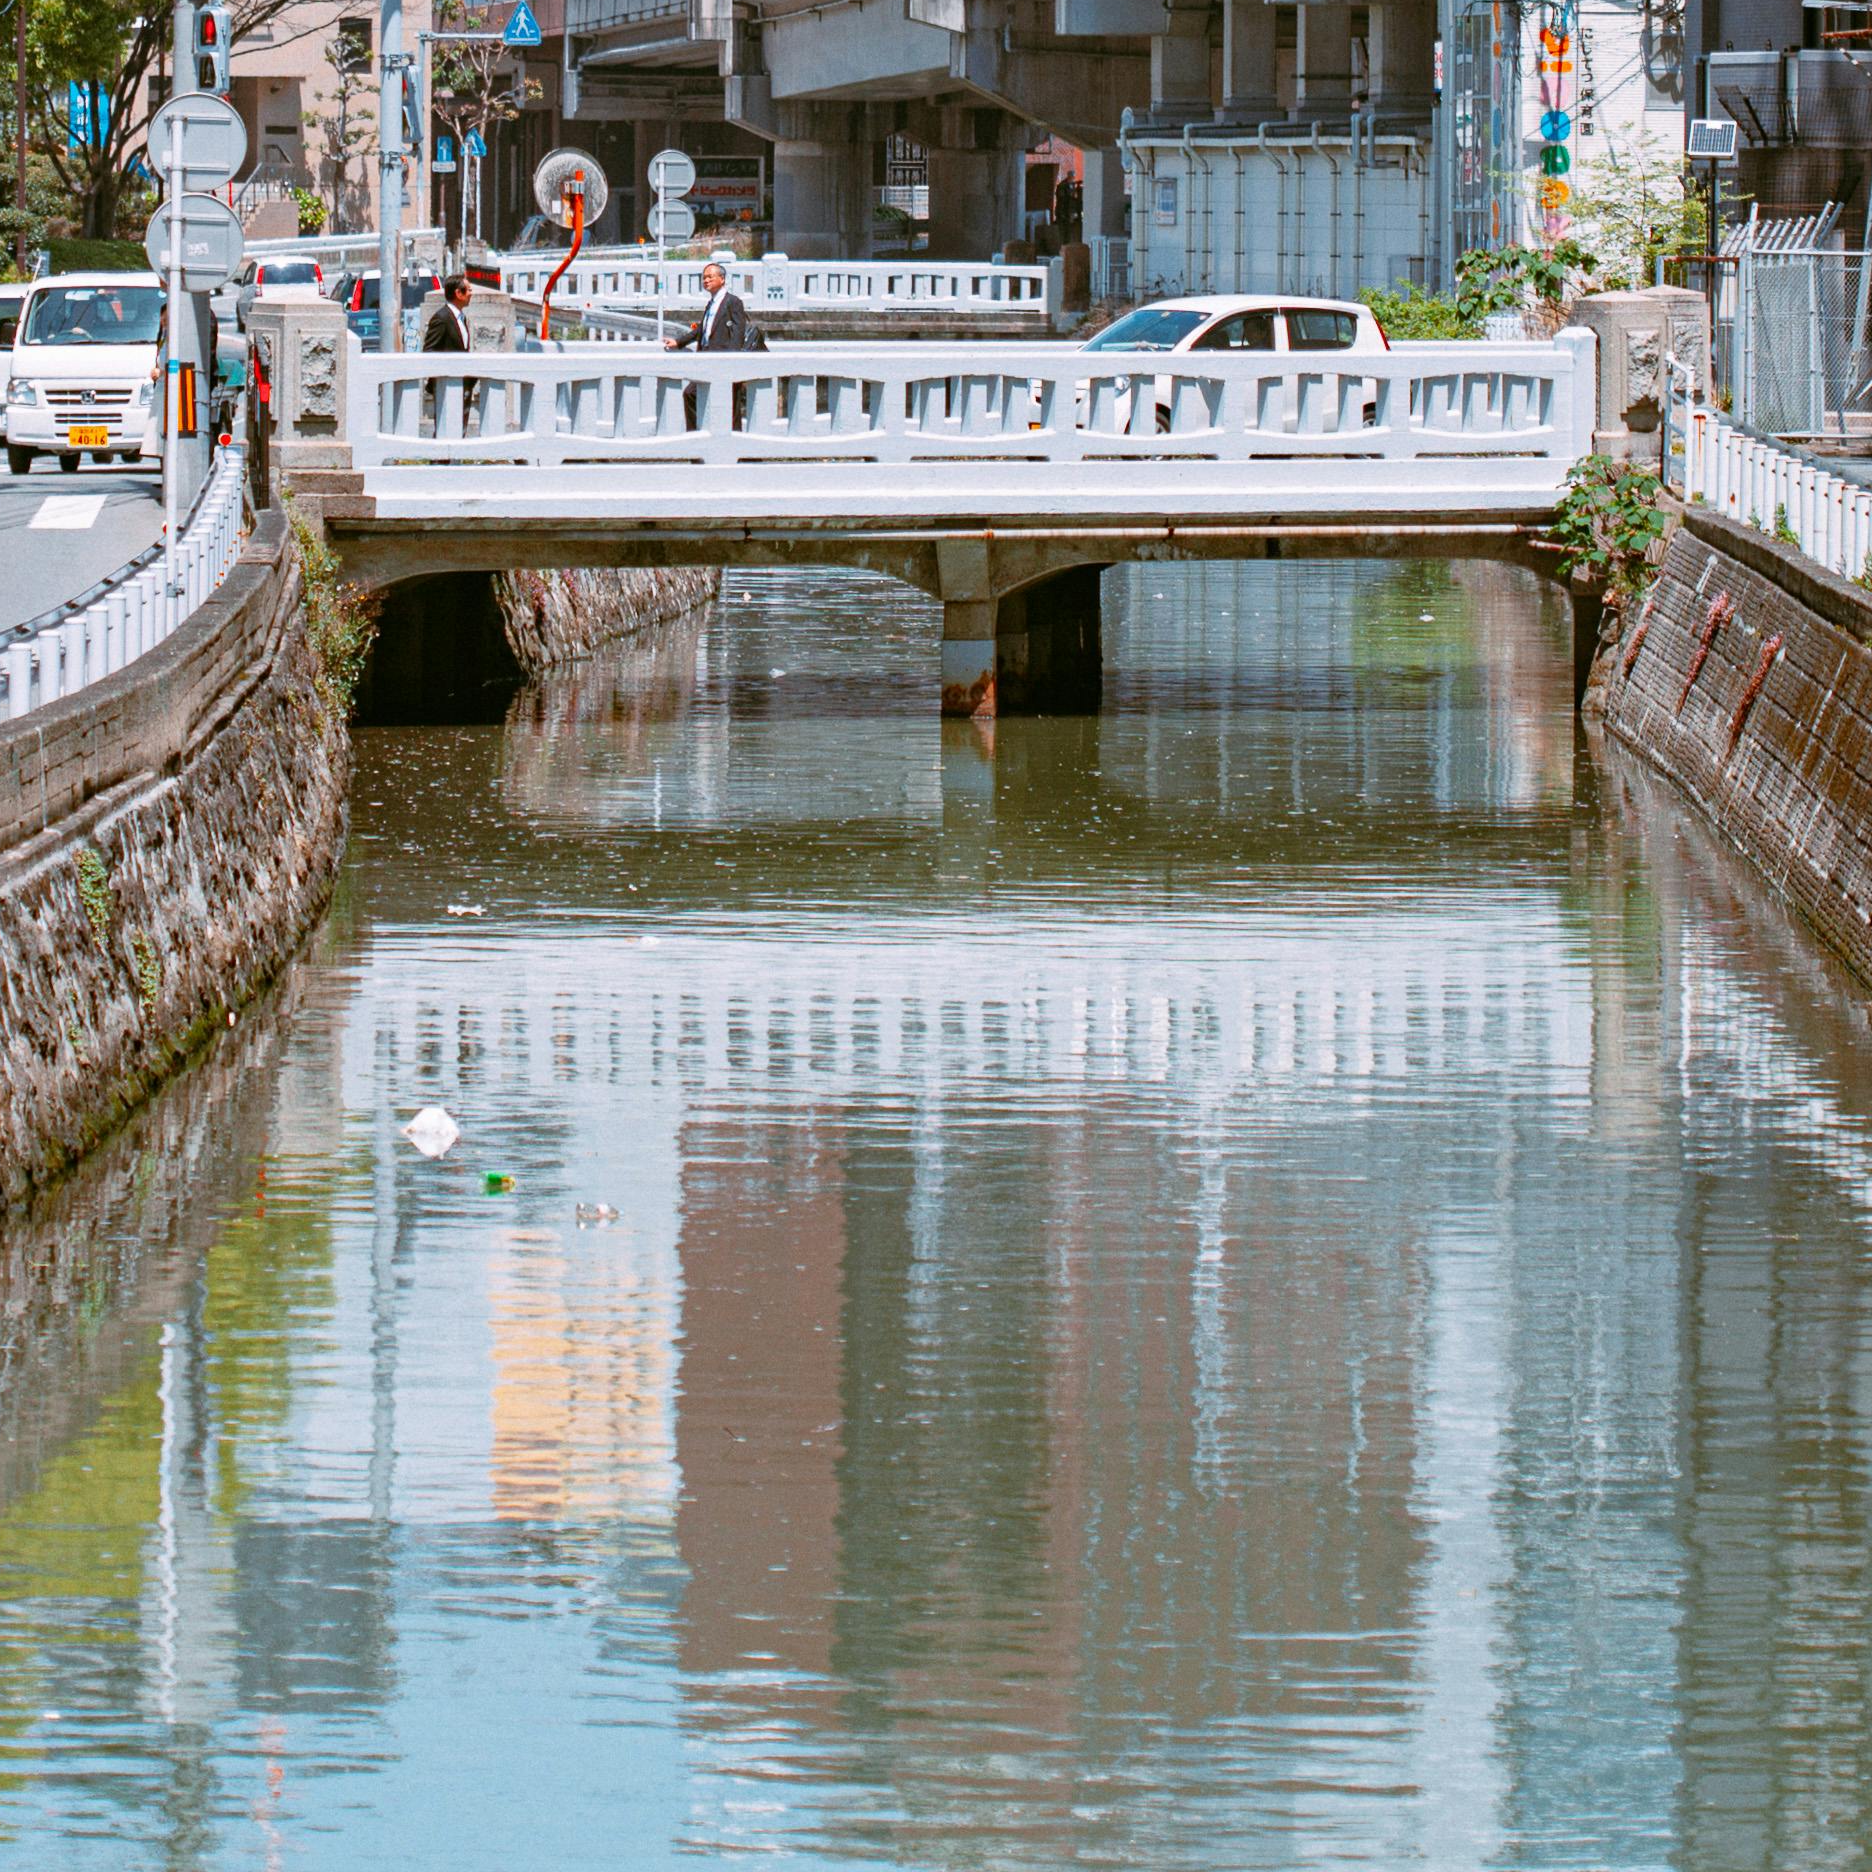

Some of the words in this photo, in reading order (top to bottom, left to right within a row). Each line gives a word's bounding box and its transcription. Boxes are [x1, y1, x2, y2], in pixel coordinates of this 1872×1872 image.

[1580, 27, 1594, 136] にしてつ保育園
[78, 435, 106, 446] 40-16
